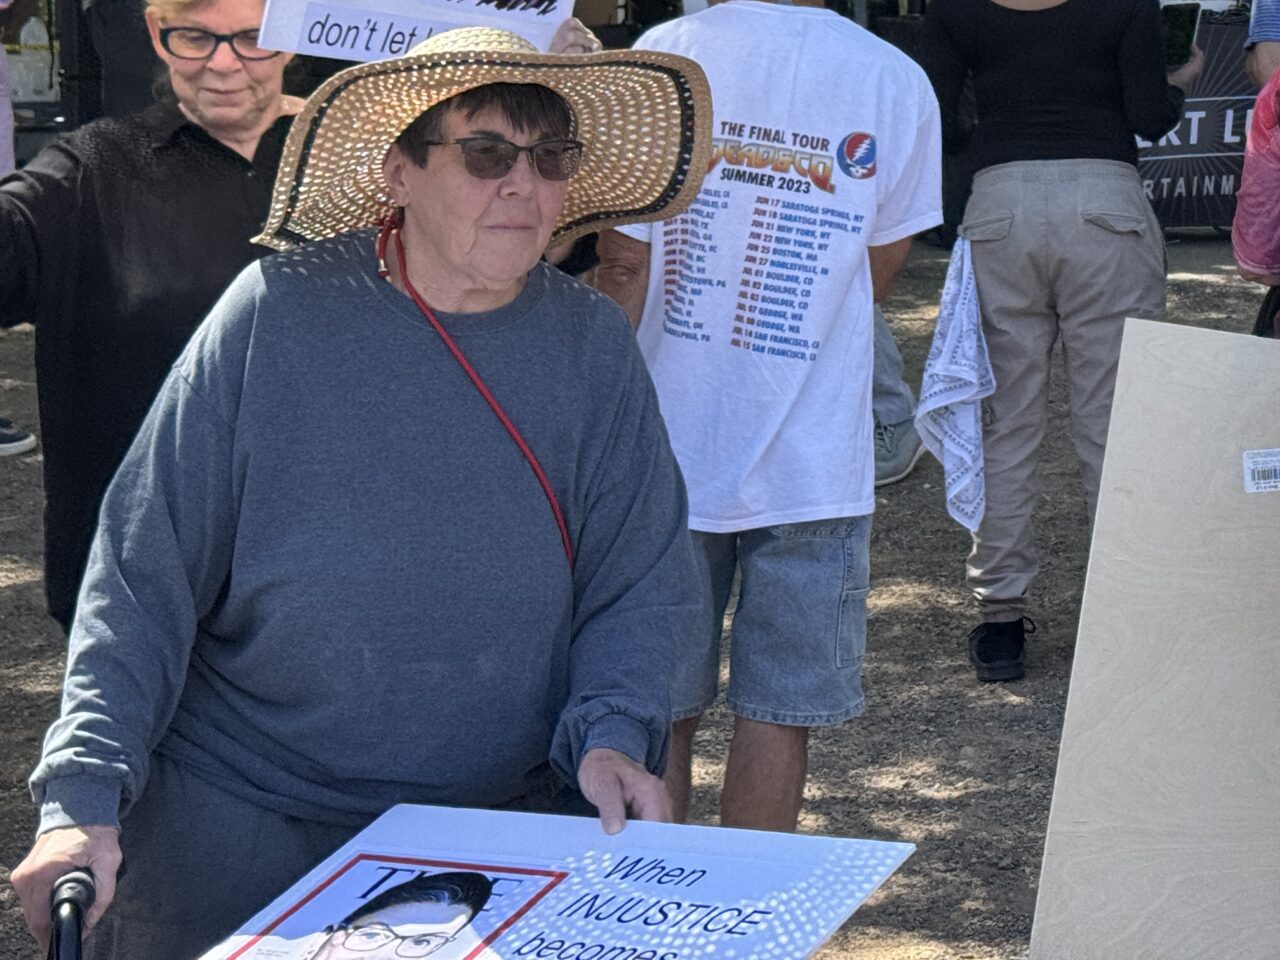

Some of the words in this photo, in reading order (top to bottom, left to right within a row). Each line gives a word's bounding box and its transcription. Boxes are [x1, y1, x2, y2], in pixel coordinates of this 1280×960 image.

[308, 13, 378, 51] don't
[380, 22, 417, 55] let
[720, 121, 746, 138] THE
[749, 126, 786, 145] FINAL
[791, 132, 830, 152] TOUR
[720, 167, 775, 188] SUMMER
[778, 176, 811, 195] 2023
[778, 212, 817, 226] SARATOGA
[781, 201, 819, 214] SARATOGA
[603, 855, 707, 888] When
[557, 892, 774, 938] INJUSTICE
[512, 931, 678, 960] becomes
